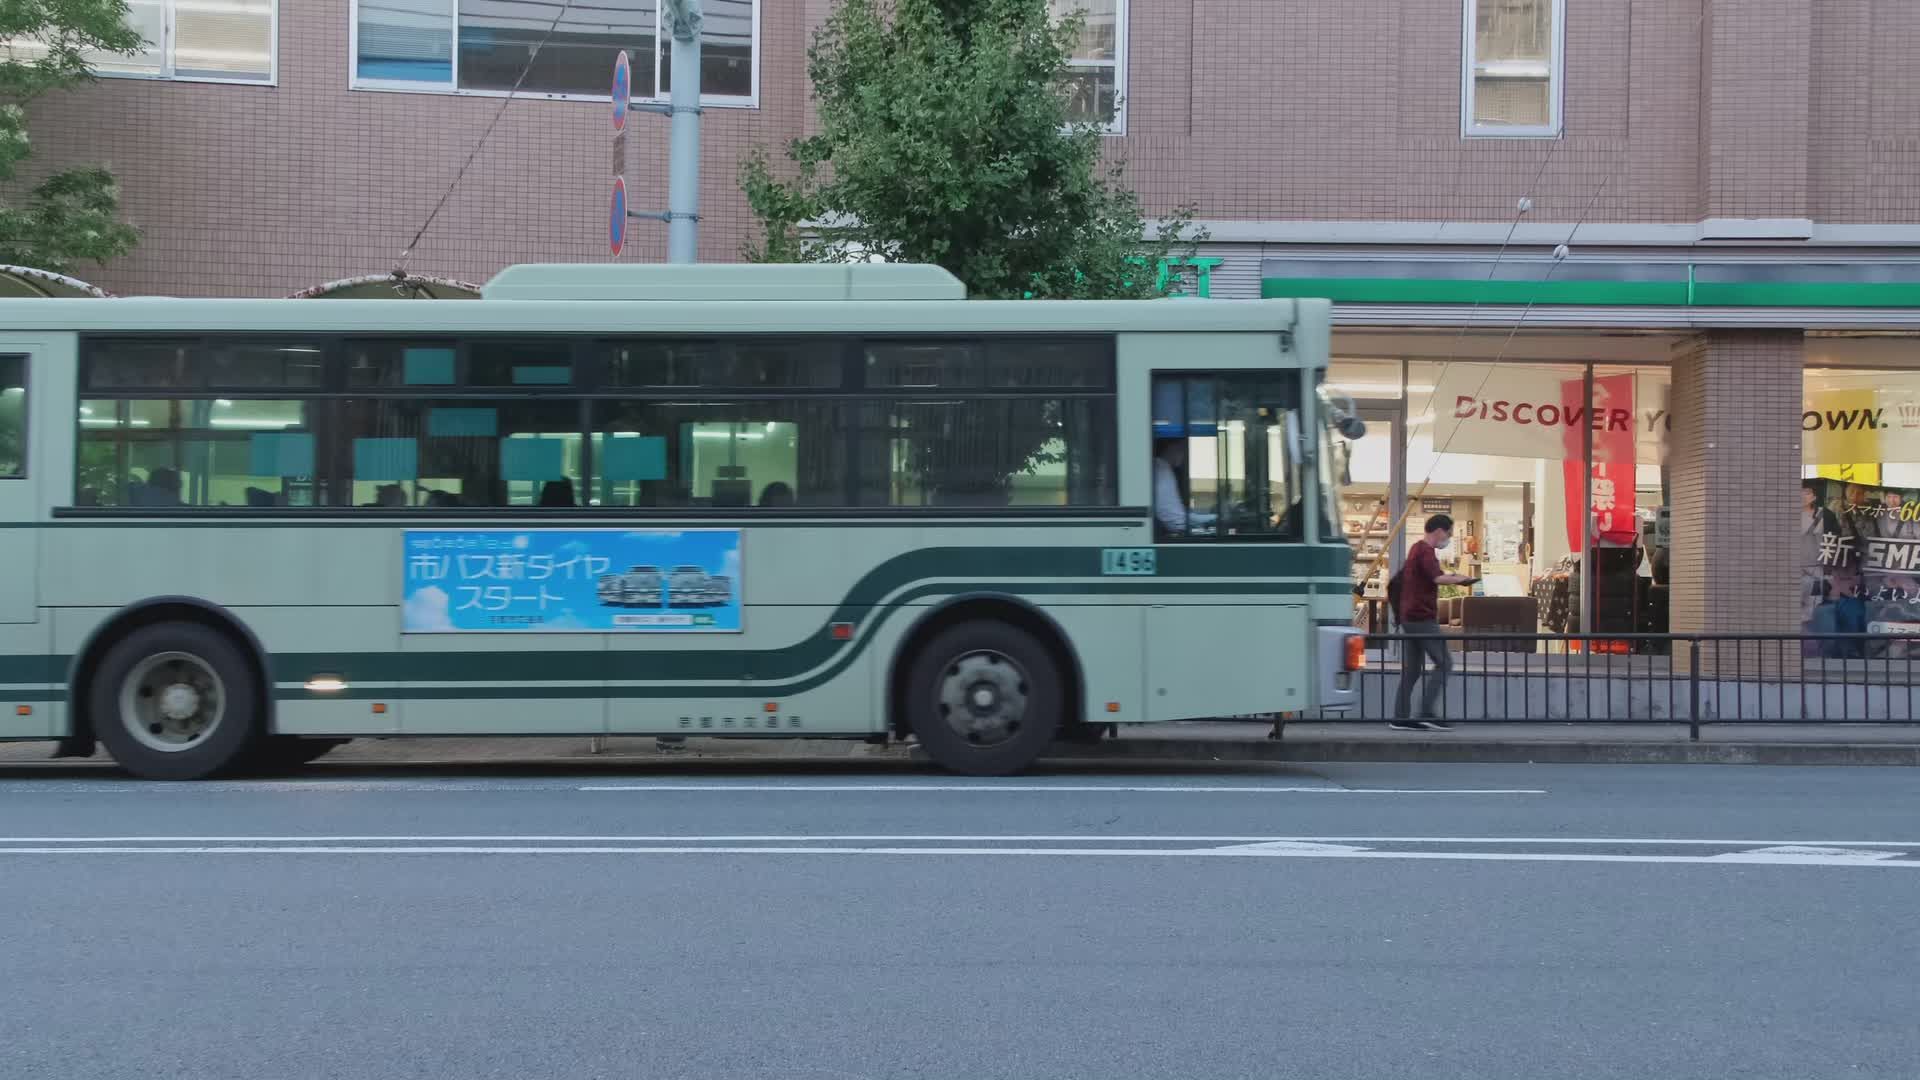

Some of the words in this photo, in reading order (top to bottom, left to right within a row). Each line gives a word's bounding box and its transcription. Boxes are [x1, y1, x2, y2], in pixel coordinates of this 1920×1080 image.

[1455, 396, 1629, 431] DISCOVER
[1645, 409, 1670, 432] Y
[1801, 408, 1888, 431] OWN.
[1107, 551, 1153, 571] 1496
[456, 585, 564, 610] スタート
